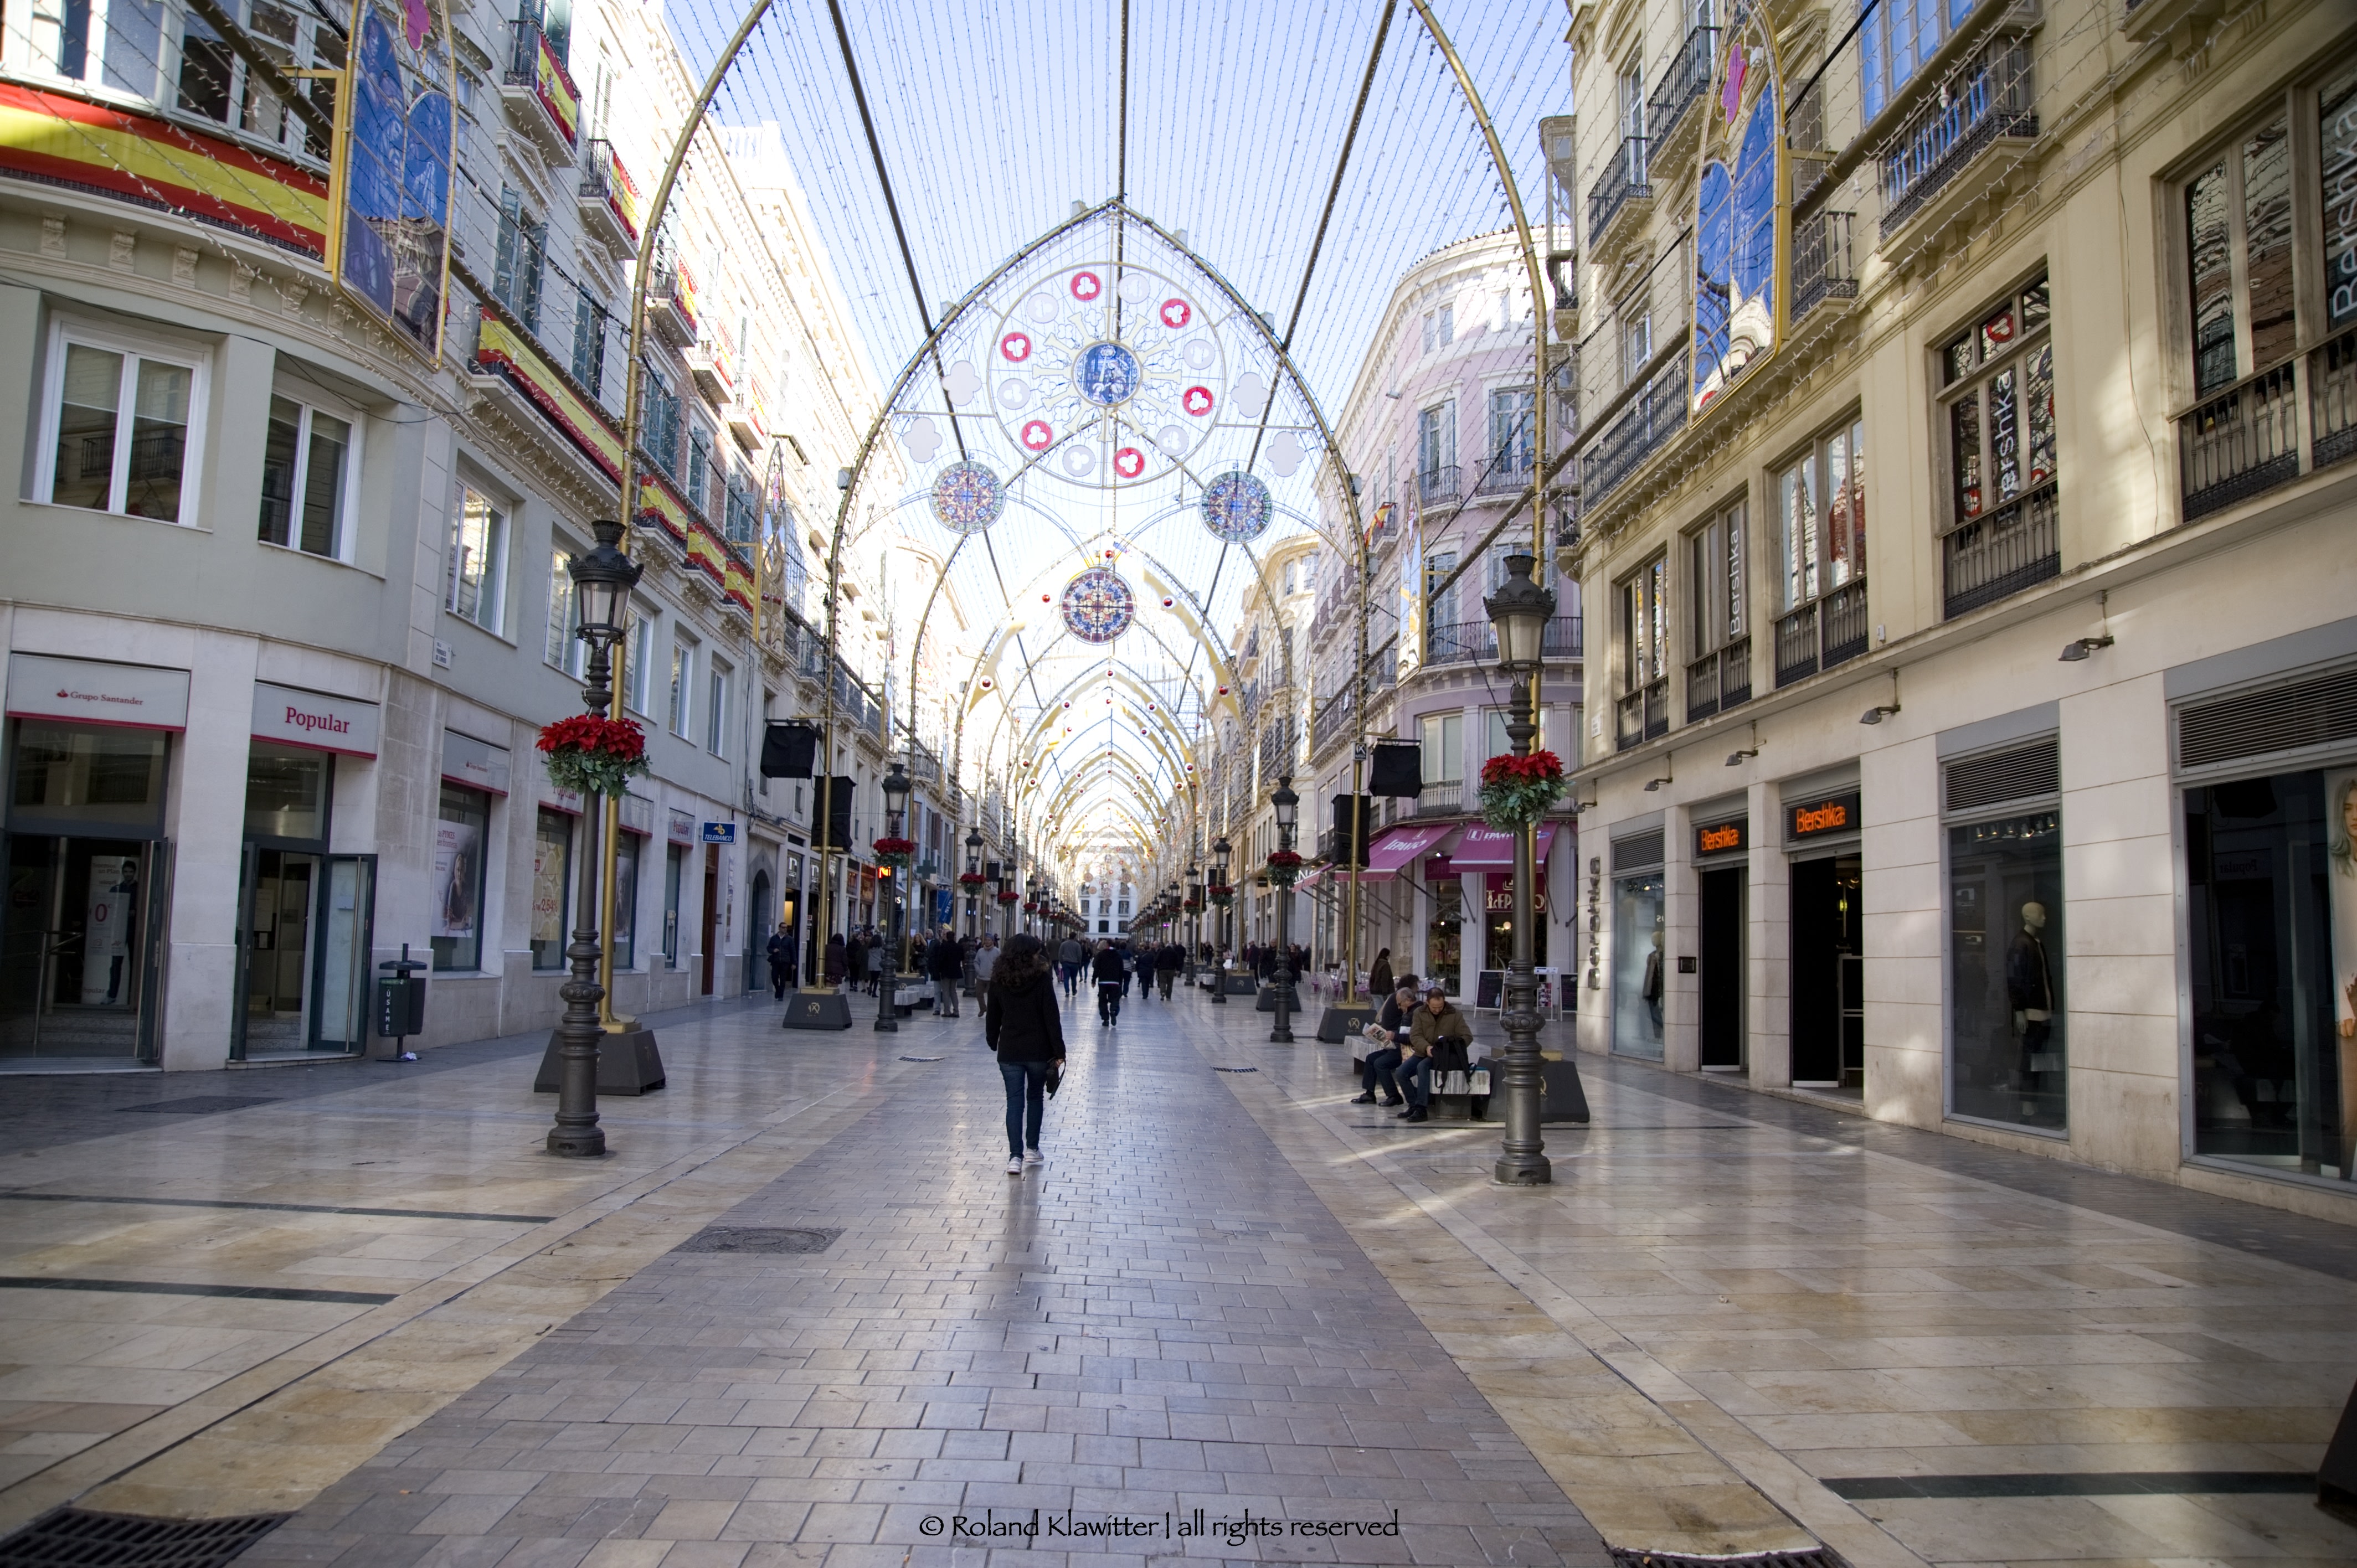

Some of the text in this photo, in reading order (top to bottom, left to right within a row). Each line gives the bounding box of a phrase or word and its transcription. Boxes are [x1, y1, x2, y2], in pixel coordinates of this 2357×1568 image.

[1729, 529, 1740, 635] Bershka
[70, 692, 144, 705] Grupo Santander
[285, 706, 350, 734] Popular
[1797, 801, 1846, 833] Bershka
[442, 829, 455, 840] PYMES
[673, 820, 689, 836] Popular
[1701, 823, 1739, 851] Bershka
[1382, 839, 1427, 851] LEPANTO
[1486, 890, 1545, 910] LEPO
